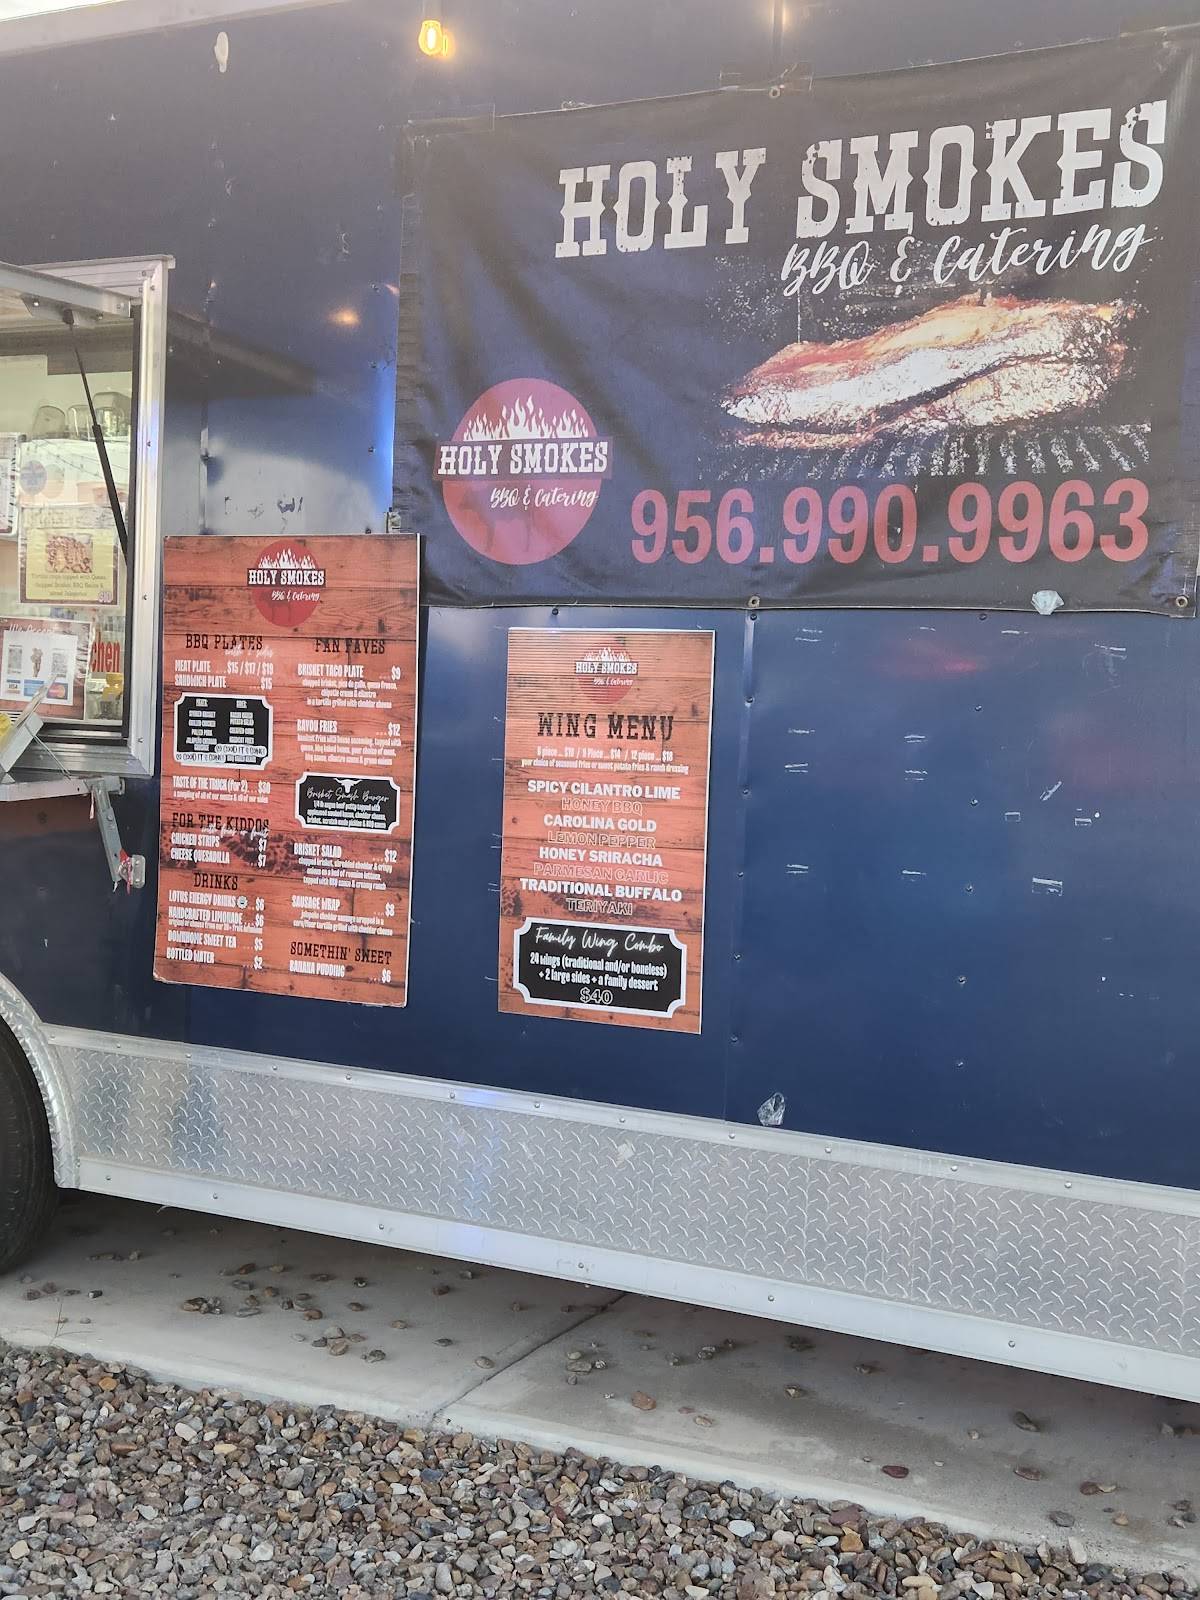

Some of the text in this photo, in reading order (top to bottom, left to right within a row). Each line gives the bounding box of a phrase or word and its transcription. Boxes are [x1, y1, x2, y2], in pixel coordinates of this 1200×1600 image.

[554, 101, 1168, 259] HOLY SMOKES
[781, 240, 872, 296] BBQ
[934, 221, 1153, 284] Catering
[438, 441, 608, 476] HOLY SMOKES
[490, 486, 519, 508] BBQ
[535, 485, 598, 508] Catering
[631, 479, 1150, 564] 956.990.9963
[249, 570, 324, 585] HOLY SMOKES
[186, 634, 263, 650] BBQ PLATES
[315, 639, 385, 654] FAN FAVES
[298, 664, 324, 675] BRISKET
[326, 664, 343, 676] TACO
[344, 665, 364, 678] PLATE
[576, 663, 637, 673] HOLY SMOKES
[175, 674, 206, 687] SANDWICH
[208, 675, 226, 688] PLATE
[297, 719, 318, 732] BAYOU
[320, 720, 337, 733] FRIES
[537, 713, 673, 740] WING MENU
[528, 780, 680, 799] SPICY CILANTRO LIME
[562, 798, 643, 815] HONEY BBQ
[172, 813, 193, 828] FOR
[199, 815, 222, 830] THE
[226, 817, 269, 832] KIDDOS
[544, 814, 656, 832] CAROLINA GOLD
[172, 832, 197, 845] CHICKEN
[198, 835, 220, 847] STRIPS
[548, 831, 656, 848] LEMON PEPPER
[171, 848, 192, 860] CHEESE
[193, 850, 230, 864] QUESADILLA
[294, 843, 320, 856] BRISKET
[322, 845, 342, 858] SALAD
[539, 847, 662, 866] HONEY SRIRACHA
[194, 873, 238, 890] DRINKS
[533, 862, 669, 884] PARMESAN GARLIC
[169, 890, 188, 902] LOTUS
[189, 891, 212, 906] ENERGY
[213, 895, 236, 908] DRINKS
[520, 878, 682, 902] TRADITIONAL BUFFALO
[292, 895, 320, 909] SAUSAGE
[321, 897, 340, 911] WRAP
[566, 898, 632, 915] TERIYAKI
[169, 906, 210, 922] HANDCRAFTED
[168, 930, 202, 945] DOWNHOME
[204, 933, 224, 947] SWEET
[226, 936, 236, 948] TEA
[536, 927, 664, 956] Family Wing Combo
[167, 947, 192, 961] BOTTLED
[194, 950, 214, 963] WATER
[290, 941, 391, 965] SOMETHIN' SWEET
[290, 960, 315, 974] BANANA
[317, 963, 345, 977] PUDDING
[530, 952, 667, 979] 24 wings (traditional and/or boneless)
[545, 969, 550, 980] 2
[551, 969, 570, 985] large
[571, 971, 590, 984] sides
[605, 974, 627, 989] family
[629, 979, 658, 991] dessert
[580, 987, 613, 1005] $40
